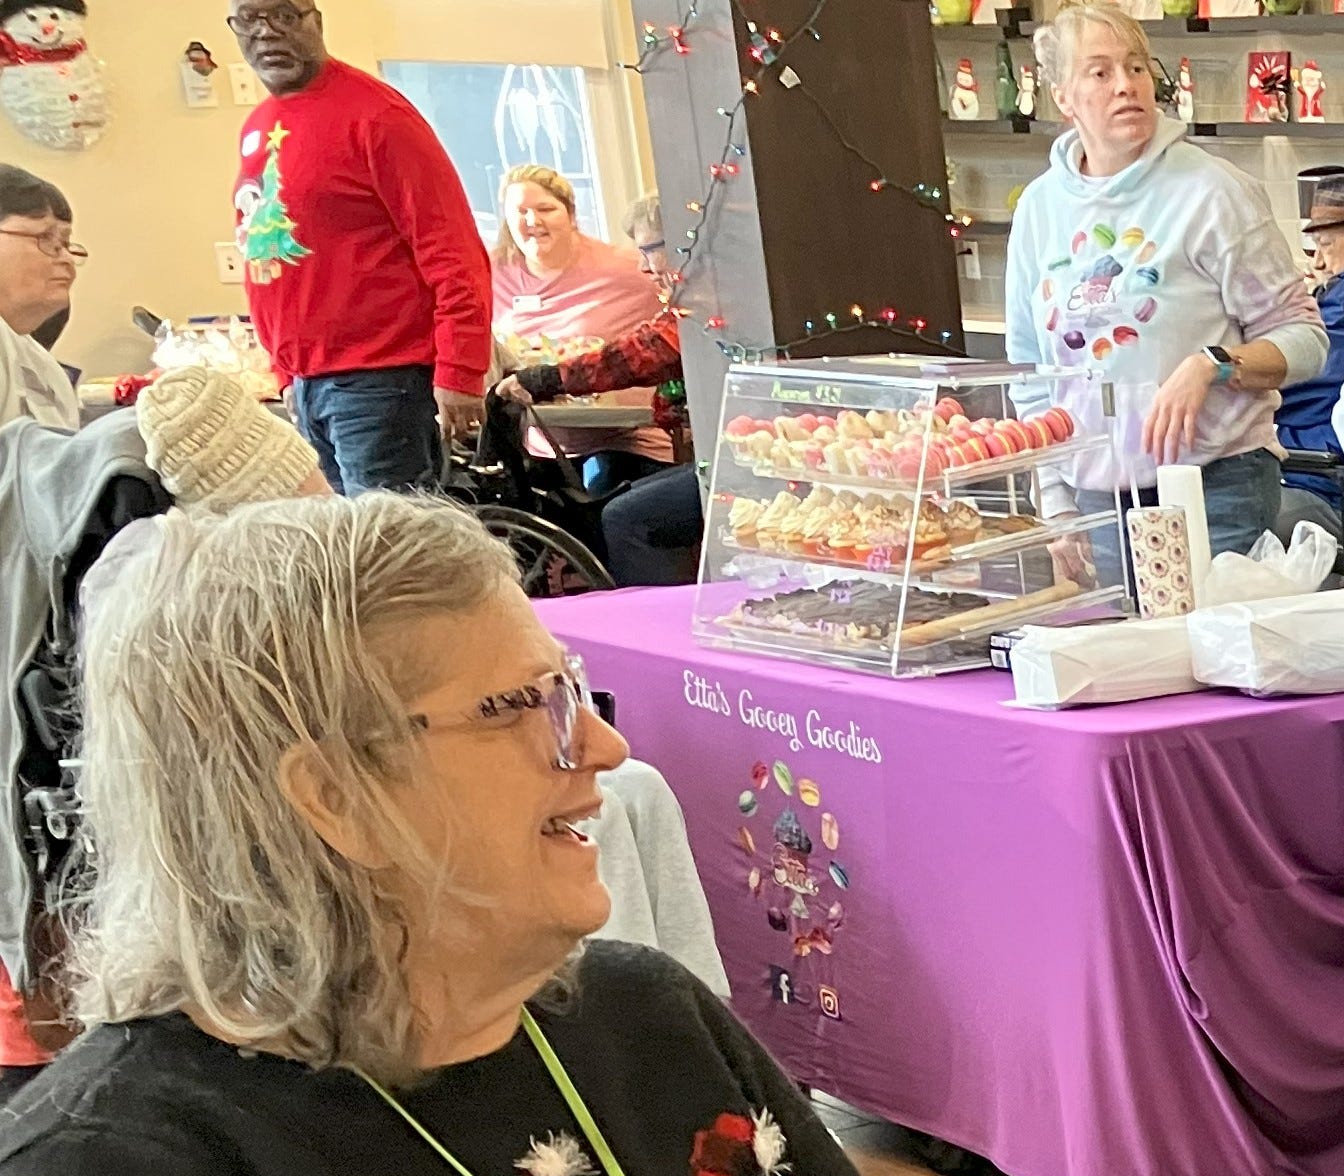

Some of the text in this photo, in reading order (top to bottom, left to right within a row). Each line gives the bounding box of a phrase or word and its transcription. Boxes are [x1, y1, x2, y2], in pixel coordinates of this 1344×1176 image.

[683, 669, 882, 763] Etta's Gooey Goodies
